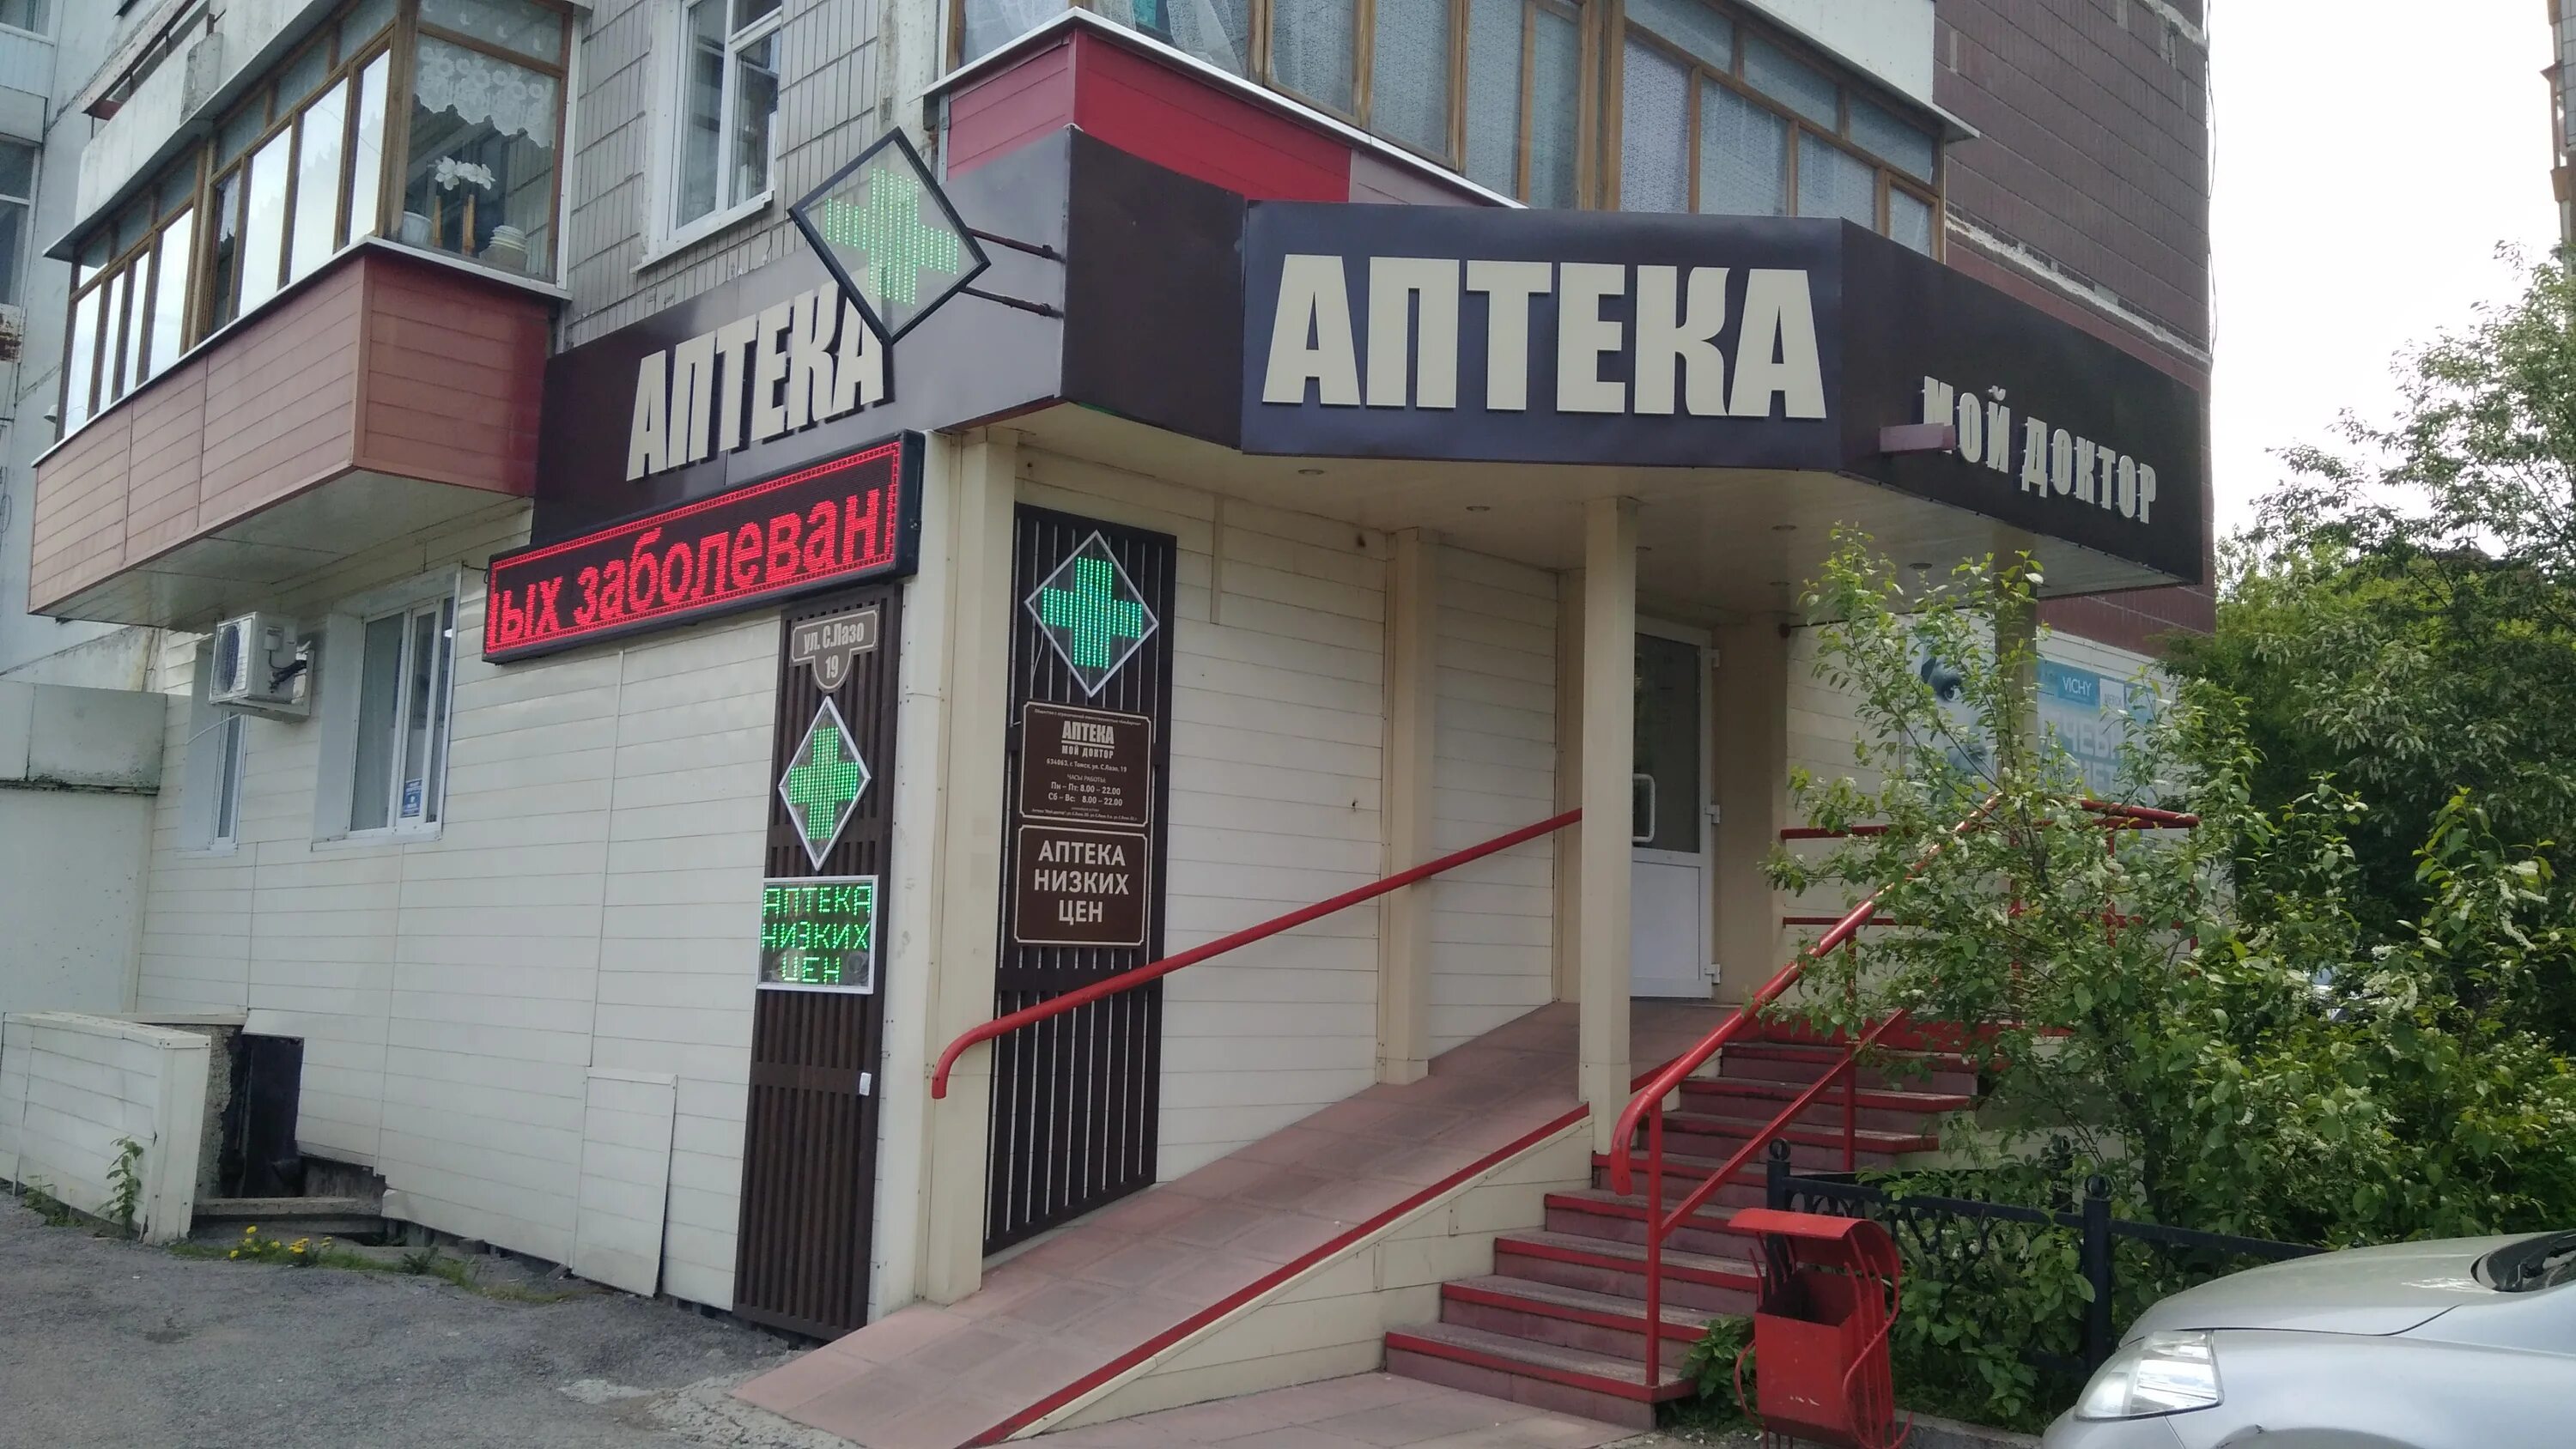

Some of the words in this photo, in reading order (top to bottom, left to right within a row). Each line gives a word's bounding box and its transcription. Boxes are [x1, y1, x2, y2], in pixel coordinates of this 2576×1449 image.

[1262, 253, 1827, 419] АПТЕКА
[627, 281, 884, 482] АПТЕКА
[1923, 376, 2010, 473] МОЙ
[2021, 416, 2156, 524] ДОКТОР
[488, 576, 563, 646] ых
[573, 485, 894, 627] заболеван
[804, 632, 820, 654] ул.
[823, 622, 865, 648] С.Лазо
[825, 655, 839, 678] 19
[2063, 676, 2092, 696] VICHY
[1062, 720, 1115, 744] АПТЕКА
[1062, 745, 1079, 755] МОЙ
[1082, 748, 1114, 759] ДОКТОР
[1051, 781, 1061, 790] Пн
[1080, 785, 1095, 793] 8.00
[1102, 786, 1121, 796] 22.00
[1104, 797, 1123, 806] 22.00
[1038, 840, 1126, 866] АПТЕКА
[1034, 869, 1129, 894] НИЗКИХ
[762, 886, 872, 918] АПТЕКА
[1059, 900, 1103, 925] ЦЕН
[762, 921, 870, 950] НИЗКИХ
[782, 953, 840, 983] ЦЕН
